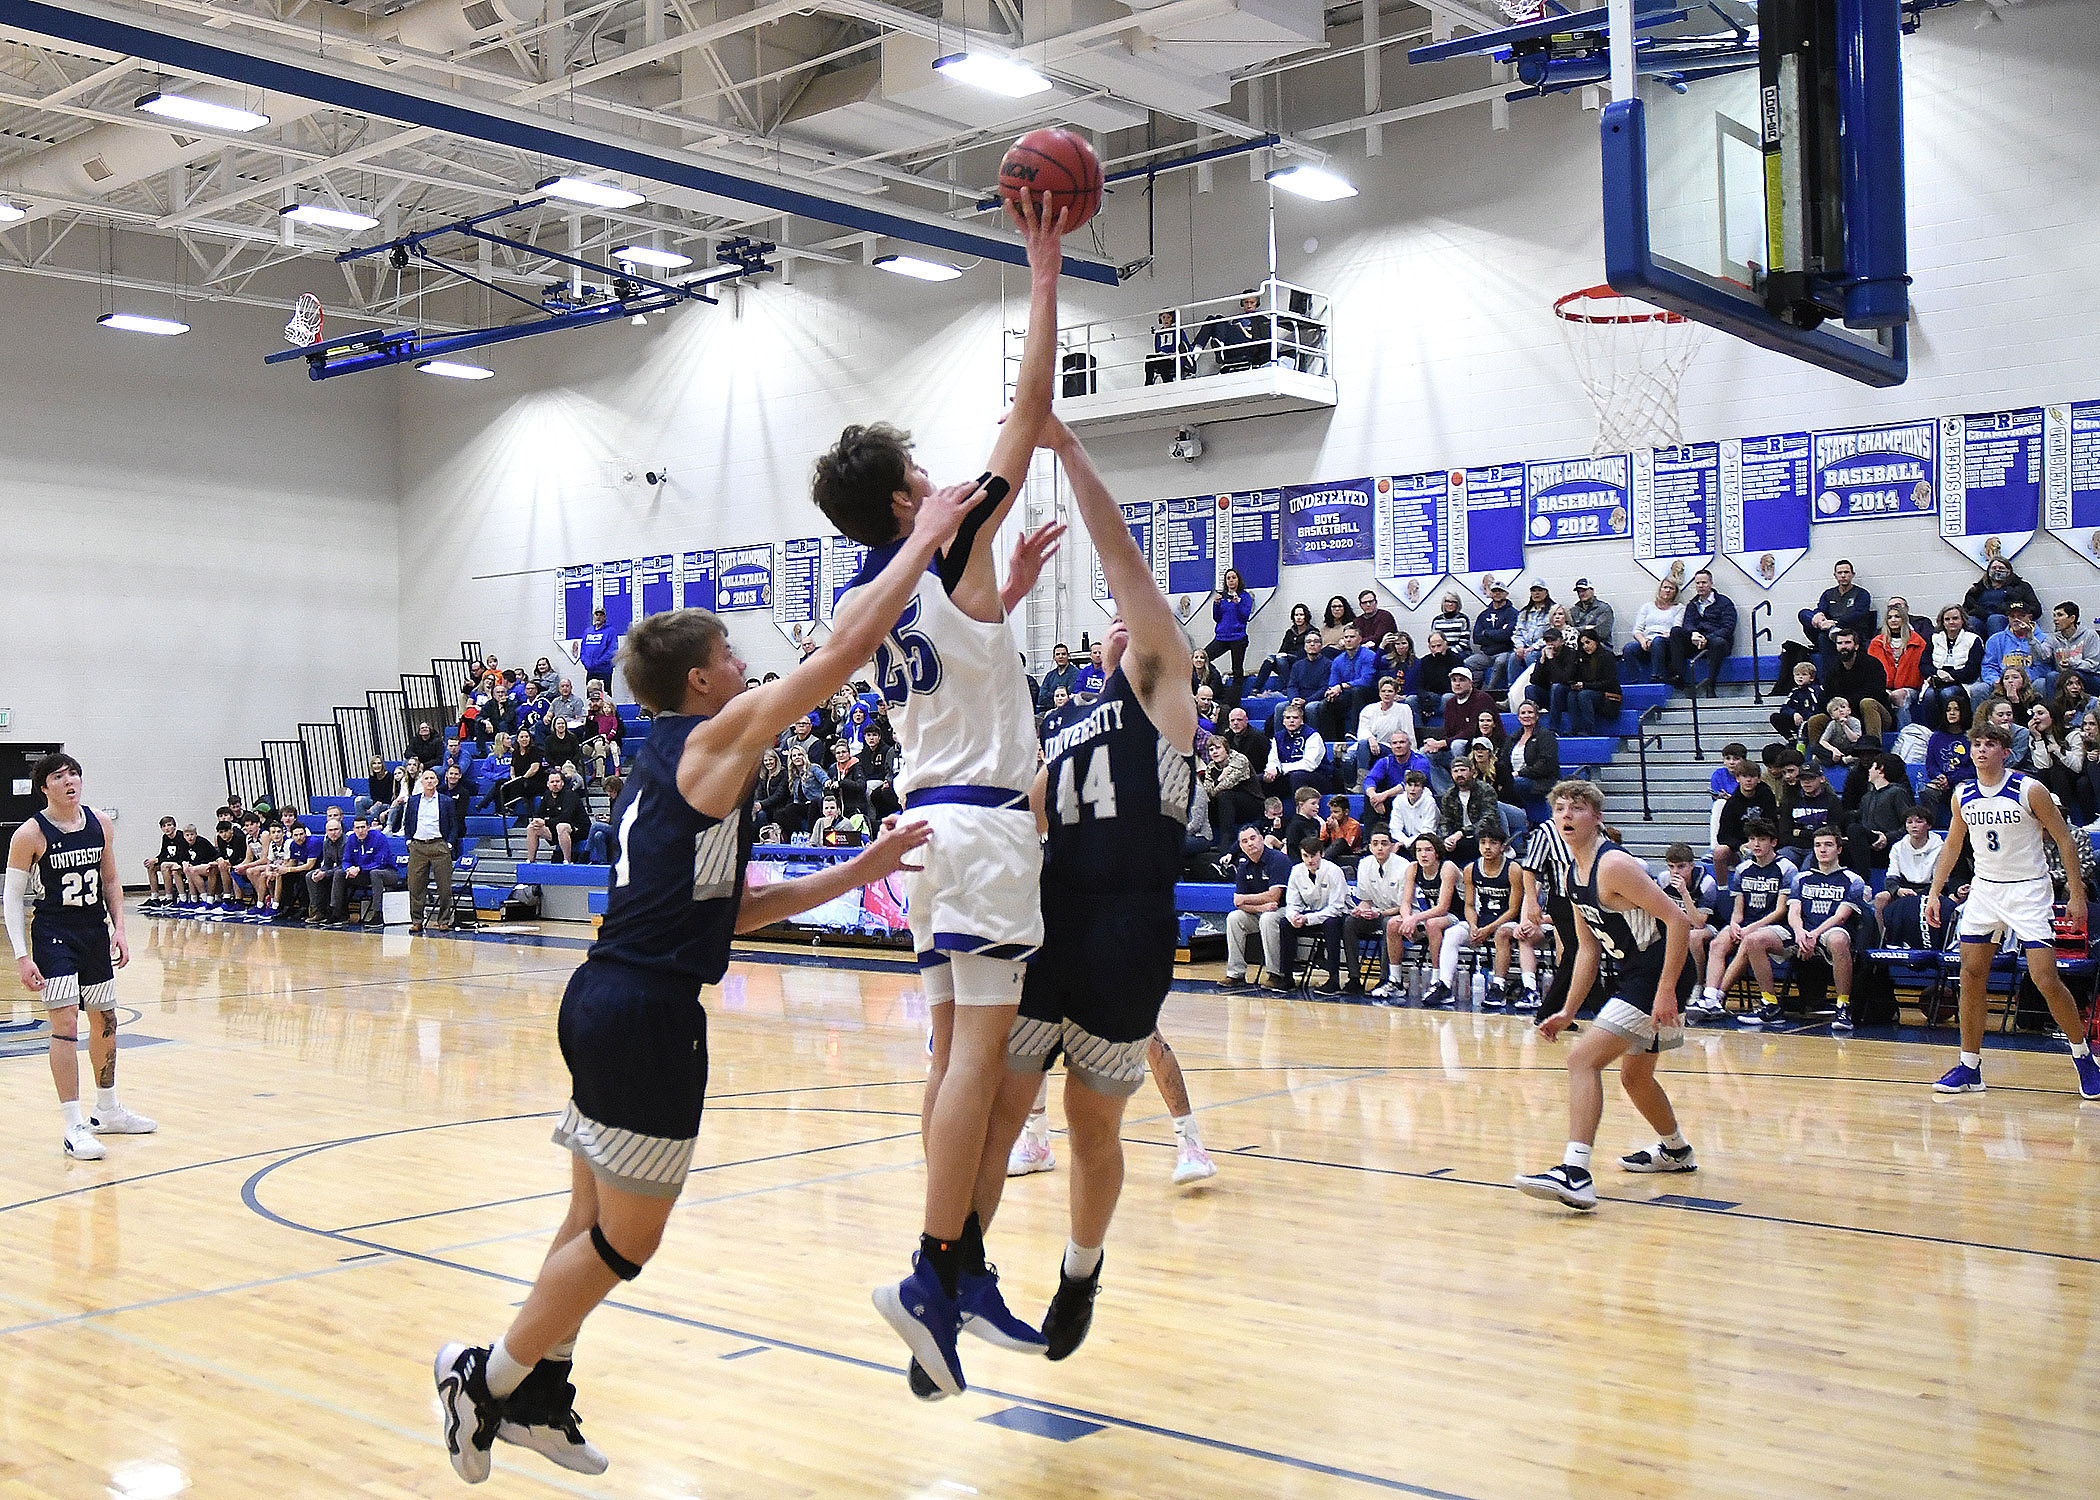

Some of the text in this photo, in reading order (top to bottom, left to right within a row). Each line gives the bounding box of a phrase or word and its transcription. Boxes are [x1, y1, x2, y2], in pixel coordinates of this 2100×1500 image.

[1816, 426, 1932, 473] STATE CHAMPIONS
[2048, 426, 2067, 457] FIELD
[1529, 456, 1626, 499] STATE CHAMPIONS
[1824, 461, 1925, 490] BASEBALL
[1944, 437, 1961, 535] GIRLS SOCCER
[2048, 465, 2067, 501] TRACK
[1288, 489, 1369, 514] UNDEFEATED
[1536, 489, 1621, 514] BASEBALL
[1636, 468, 1651, 557] BASEBALL
[1723, 460, 1740, 552] BASEBALL
[1848, 489, 1900, 514] 2014
[2048, 499, 2067, 528] BOYS
[1297, 522, 1361, 538] BASKETBALL
[1313, 512, 1340, 525] BOYS
[1557, 514, 1600, 537] 2012
[1155, 518, 1167, 570] HOCKEY
[1304, 538, 1354, 552] 2019-2020
[720, 571, 769, 589] VOLLEYBALL
[732, 590, 757, 605] 2013
[1044, 700, 1124, 764] UNIVERSITY
[1056, 743, 1118, 825] 44
[1965, 810, 2021, 826] COUGARS
[1986, 829, 2001, 852] 3
[61, 868, 99, 907] 23
[1741, 878, 1780, 892] UNIVERSITY
[1801, 884, 1846, 900] UNIVERSITY
